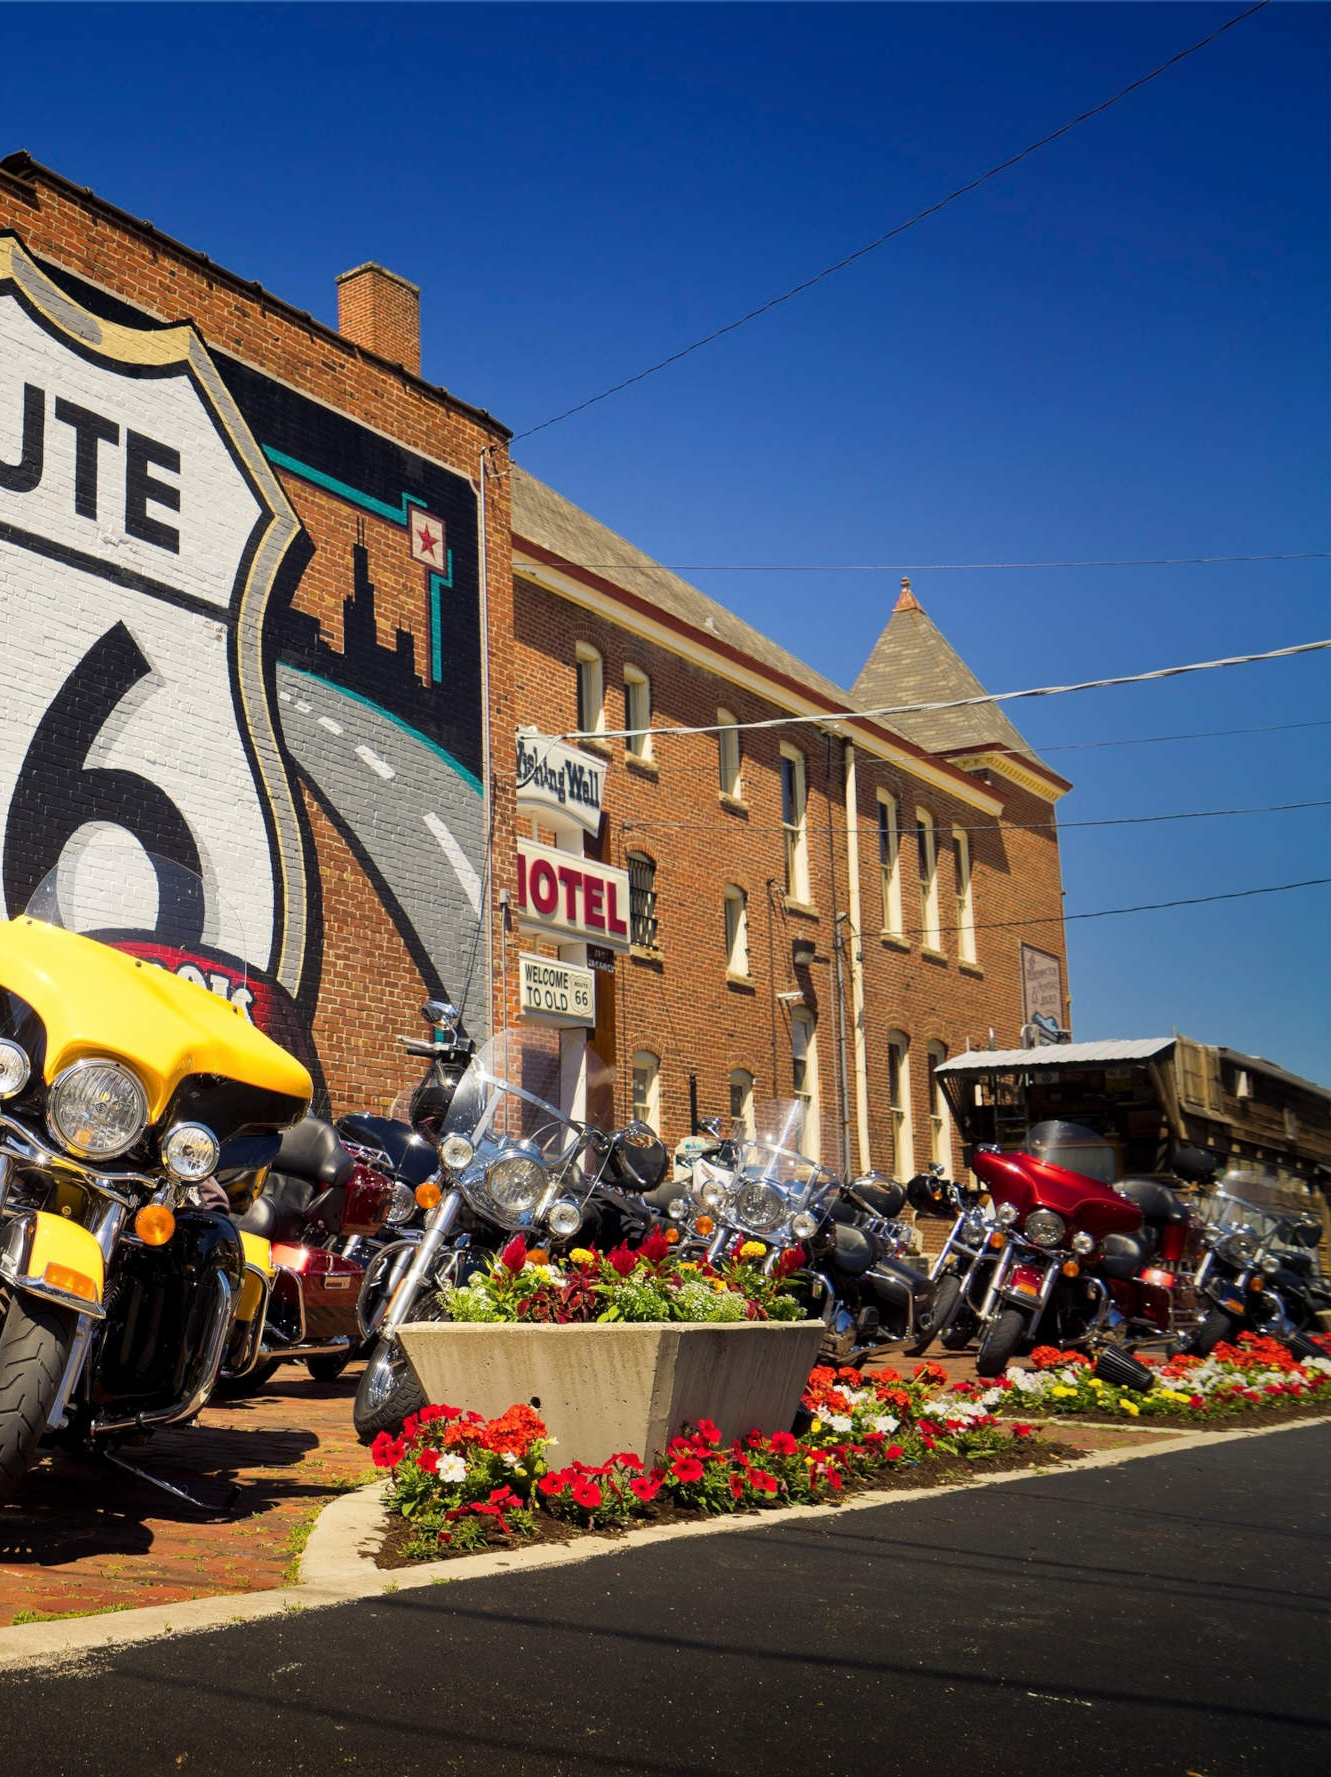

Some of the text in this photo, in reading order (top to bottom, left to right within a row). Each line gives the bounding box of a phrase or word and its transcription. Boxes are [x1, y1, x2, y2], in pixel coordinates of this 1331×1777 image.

[565, 759, 600, 809] Well
[524, 963, 569, 990] WELCOME
[526, 985, 568, 1011] TO OLD
[575, 990, 589, 1006] 66
